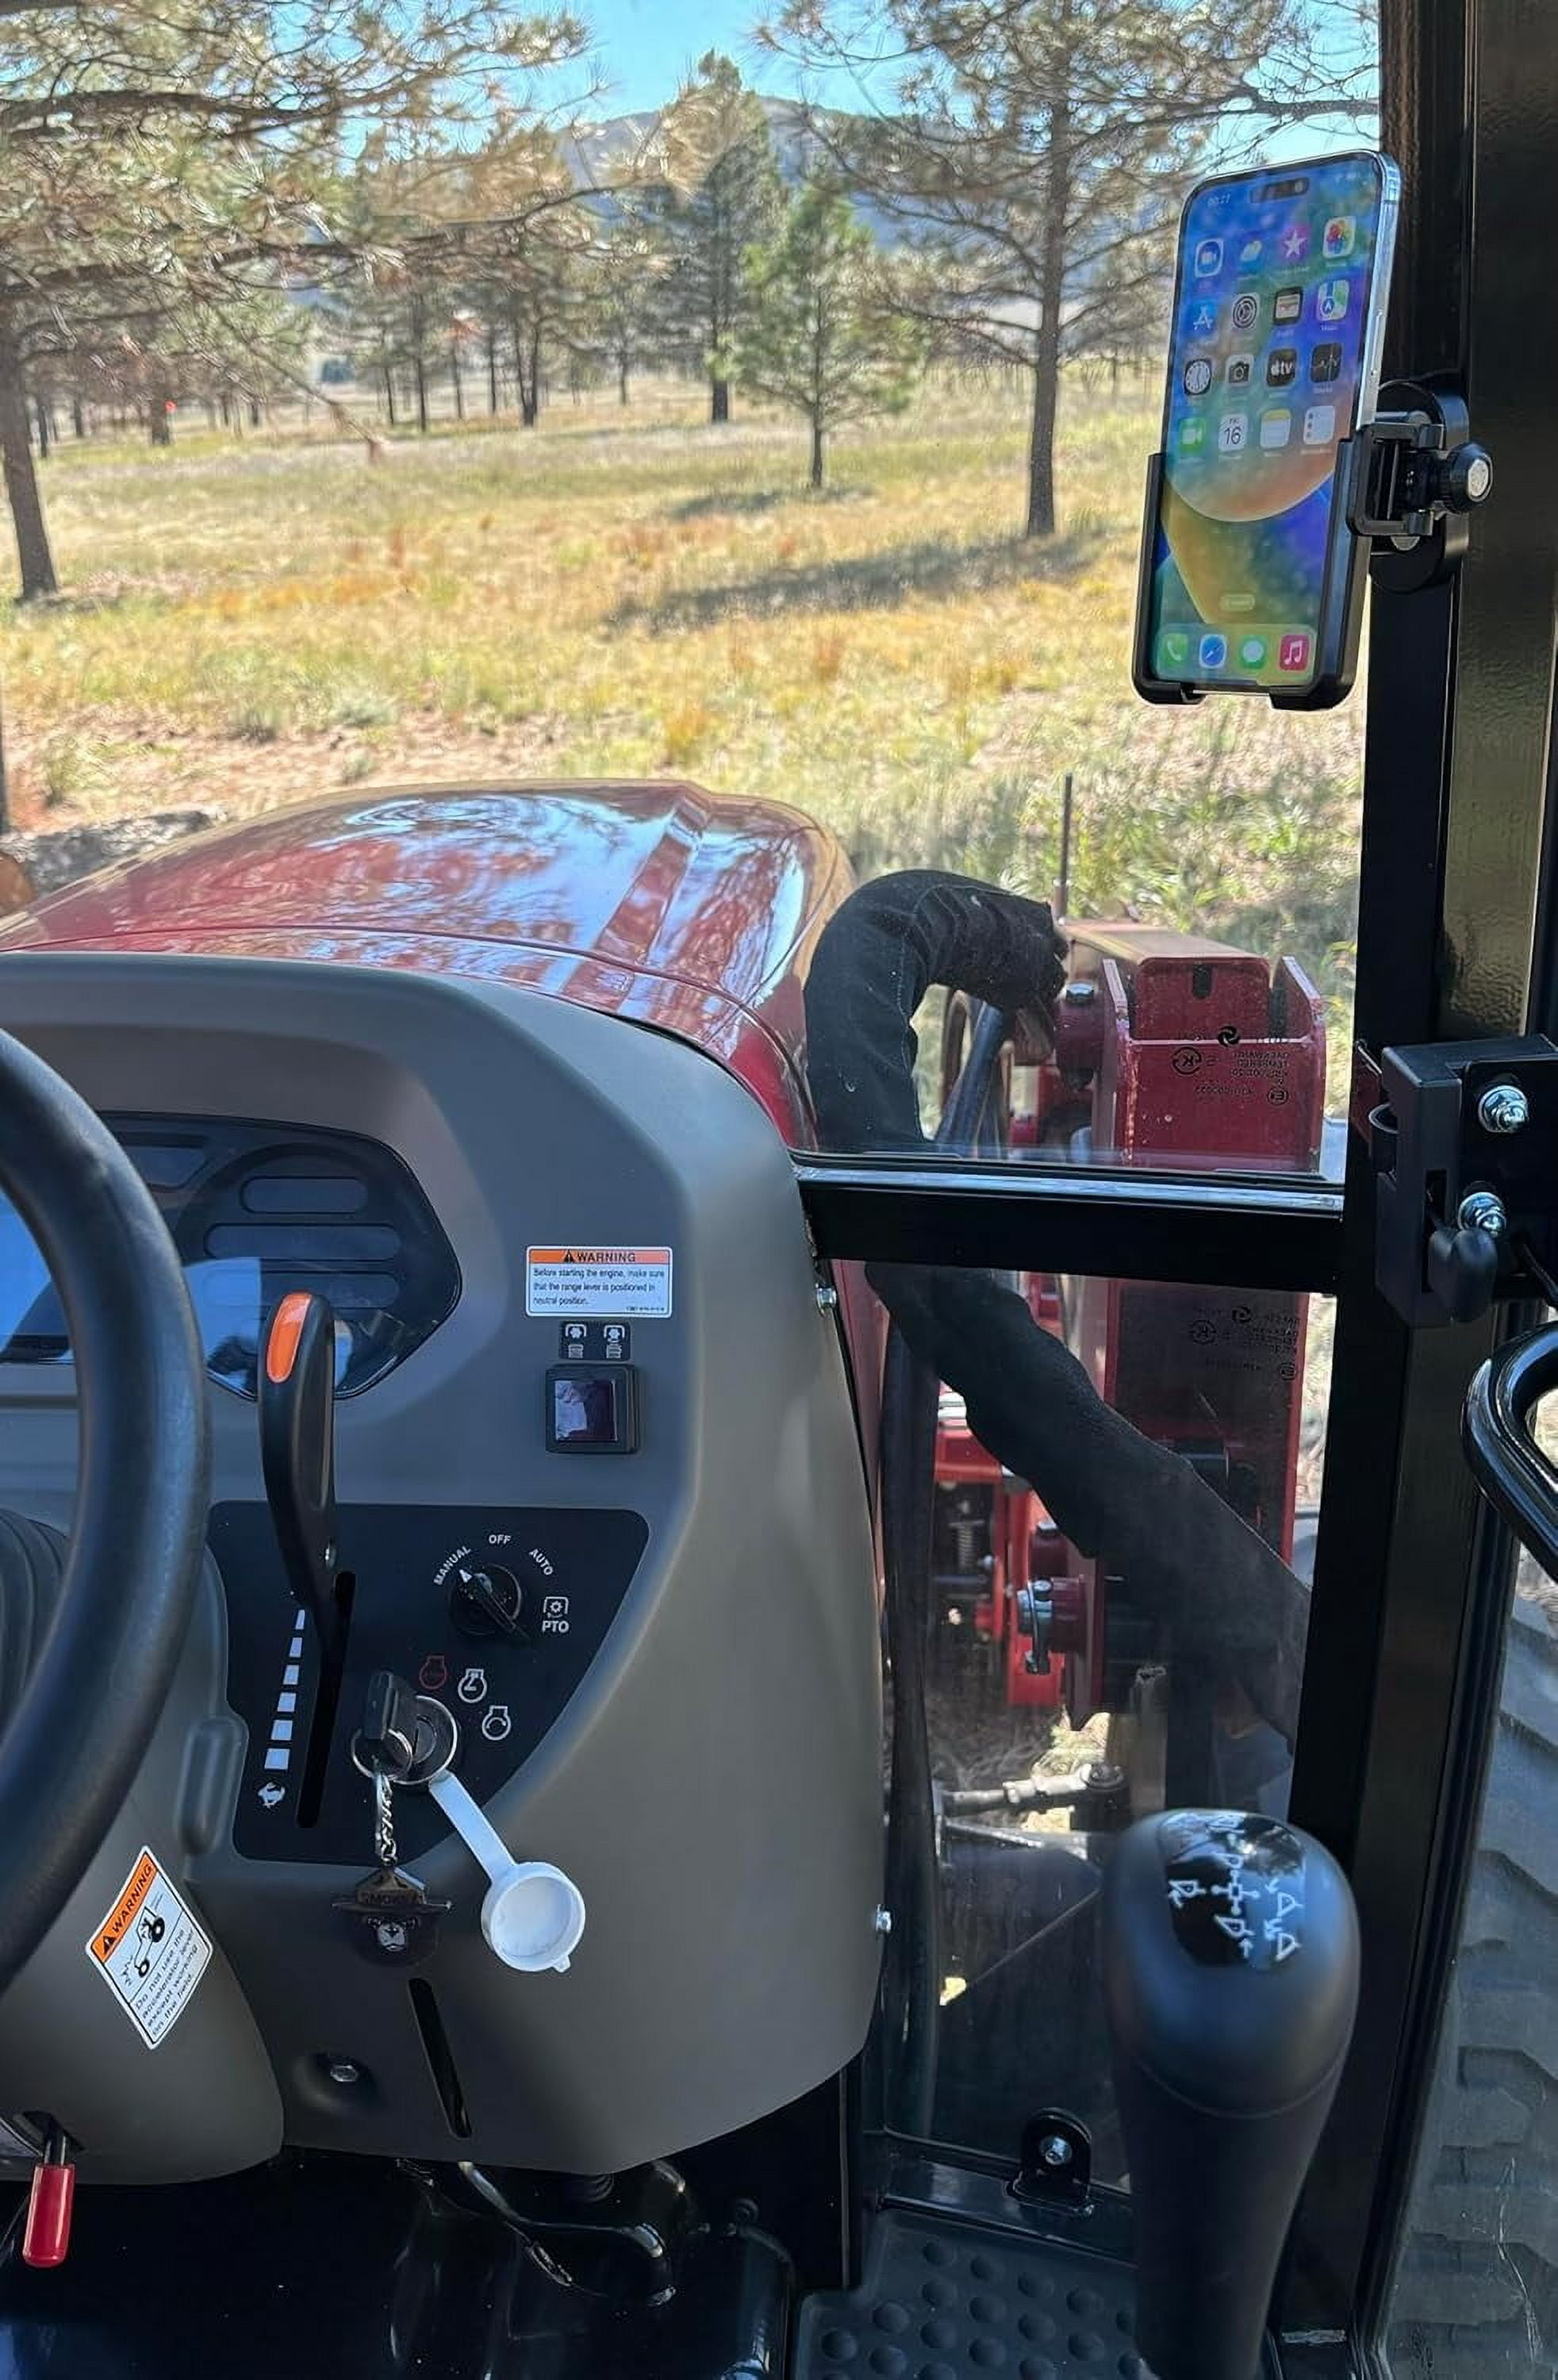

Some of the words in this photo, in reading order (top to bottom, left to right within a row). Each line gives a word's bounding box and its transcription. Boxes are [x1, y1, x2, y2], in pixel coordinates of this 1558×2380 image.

[1224, 426, 1241, 445] 16
[577, 1252, 635, 1262] WARNING
[559, 1269, 584, 1279] starting
[610, 1283, 647, 1292] positioned
[489, 1534, 512, 1545] OFF
[433, 1545, 471, 1585] MANUAL
[528, 1549, 554, 1576] AUTO
[541, 1620, 570, 1633] PTO
[112, 1863, 152, 1932] WARNING
[136, 1990, 148, 2011] Do
[148, 1970, 161, 1992] not
[160, 1948, 174, 1971] use
[173, 1928, 185, 1947] the
[141, 1957, 180, 2021] accelerator
[148, 1987, 173, 2029] except
[172, 1943, 198, 1987] working
[164, 1998, 177, 2019] the
